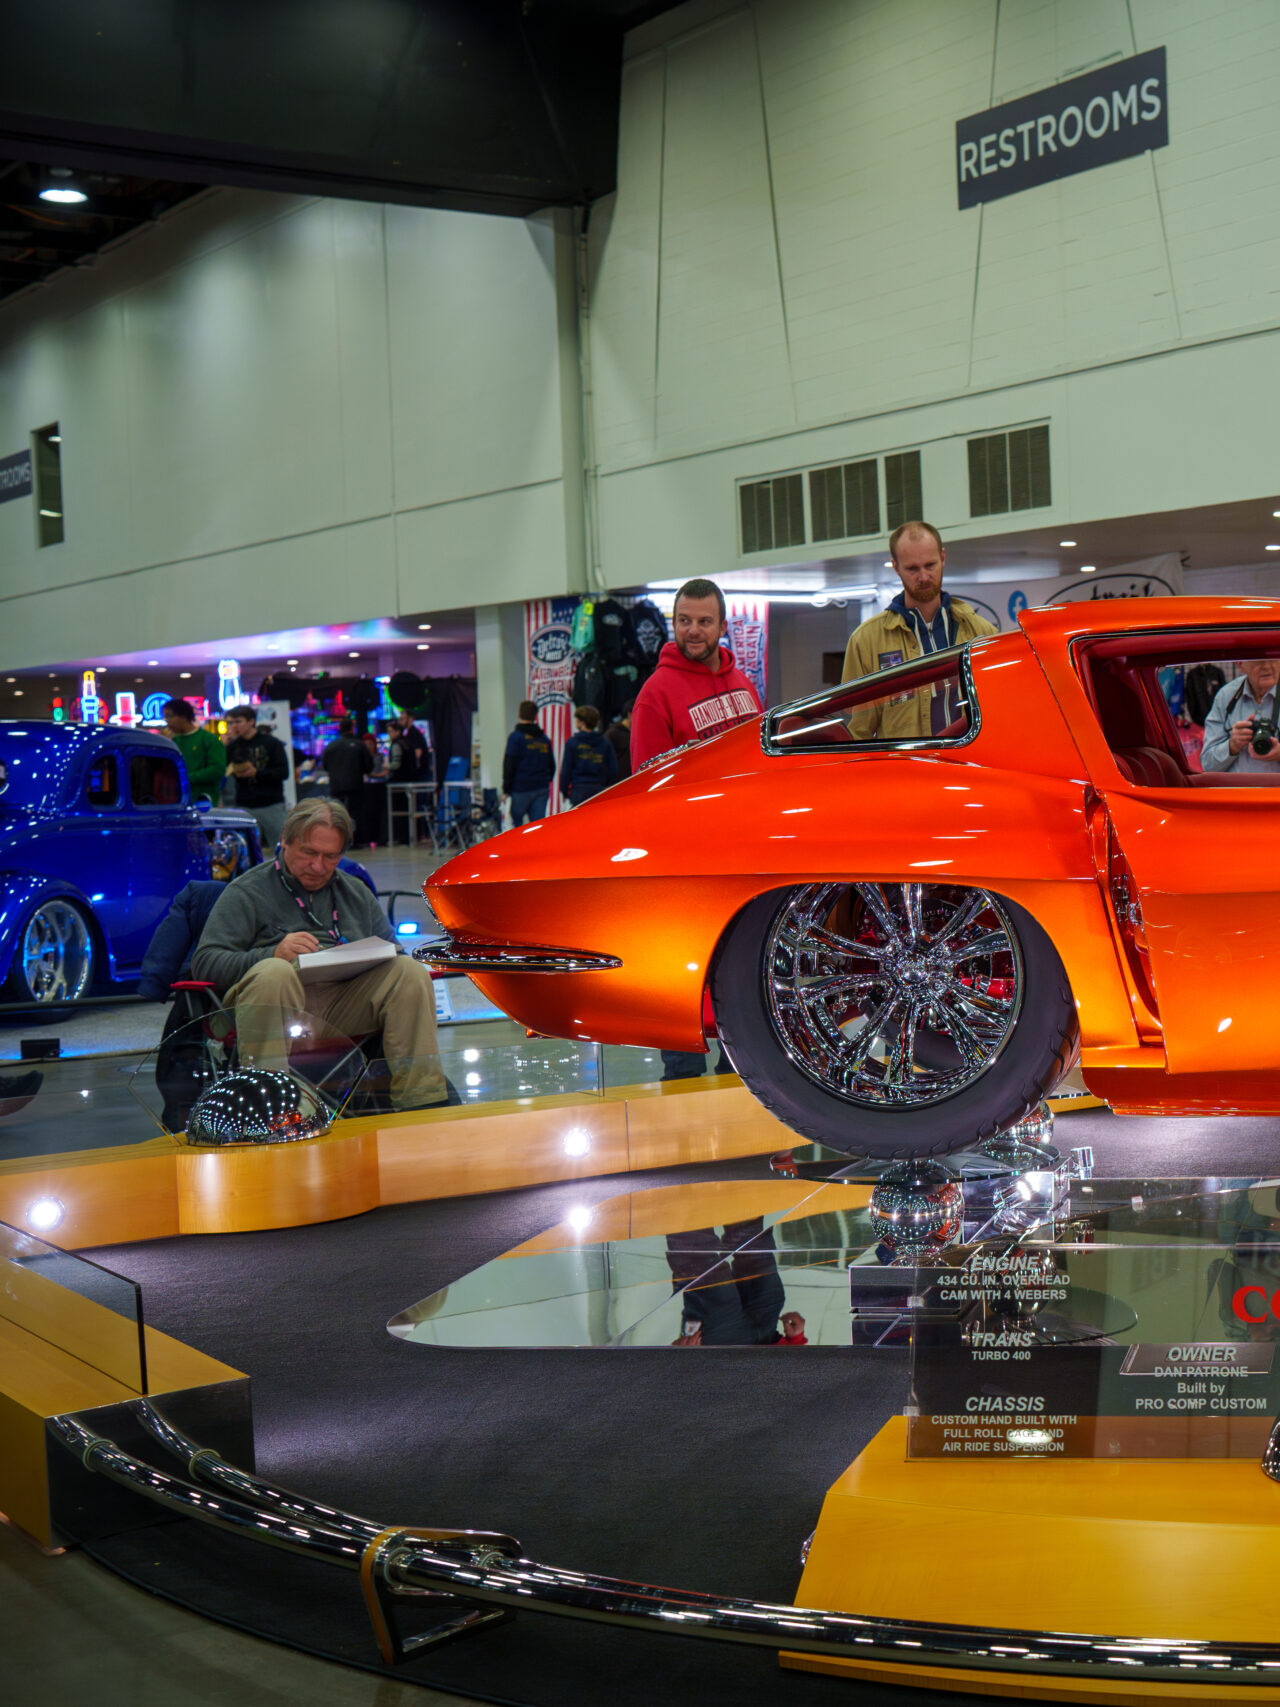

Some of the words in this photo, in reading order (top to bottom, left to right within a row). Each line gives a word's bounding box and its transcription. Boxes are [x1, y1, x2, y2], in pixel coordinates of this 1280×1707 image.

[960, 78, 1161, 182] RESTROOMS
[970, 1256, 1040, 1271] ENGINE
[937, 1275, 958, 1286] 434
[1002, 1275, 1071, 1286] OVERHEAD
[940, 1290, 967, 1300] CAM
[970, 1290, 1001, 1300] WITH
[1004, 1290, 1011, 1300] 4
[1014, 1290, 1067, 1300] WEBERS
[971, 1333, 1033, 1347] TRANS
[971, 1351, 1010, 1360] TURBO
[1012, 1351, 1031, 1360] 400
[1168, 1346, 1237, 1362] OWNER
[1154, 1366, 1182, 1377] DAN
[1186, 1366, 1248, 1377] PATRONE
[1177, 1382, 1206, 1393] Built
[1209, 1382, 1226, 1396] by
[965, 1397, 1045, 1412] CHASSIS
[1135, 1398, 1164, 1409] PRO
[1167, 1398, 1207, 1409] COMP
[1210, 1398, 1267, 1409] CUSTOM
[931, 1415, 977, 1424] CUSTOM
[980, 1415, 1012, 1424] HAND
[1014, 1415, 1046, 1424] BUILT
[1048, 1415, 1077, 1424] WITH
[943, 1429, 971, 1438] FULL
[974, 1429, 1003, 1438] ROLL
[1040, 1429, 1064, 1438] AND
[942, 1442, 961, 1451] AIR
[964, 1442, 991, 1451] RIDE
[993, 1442, 1064, 1451] SUSPENSION
